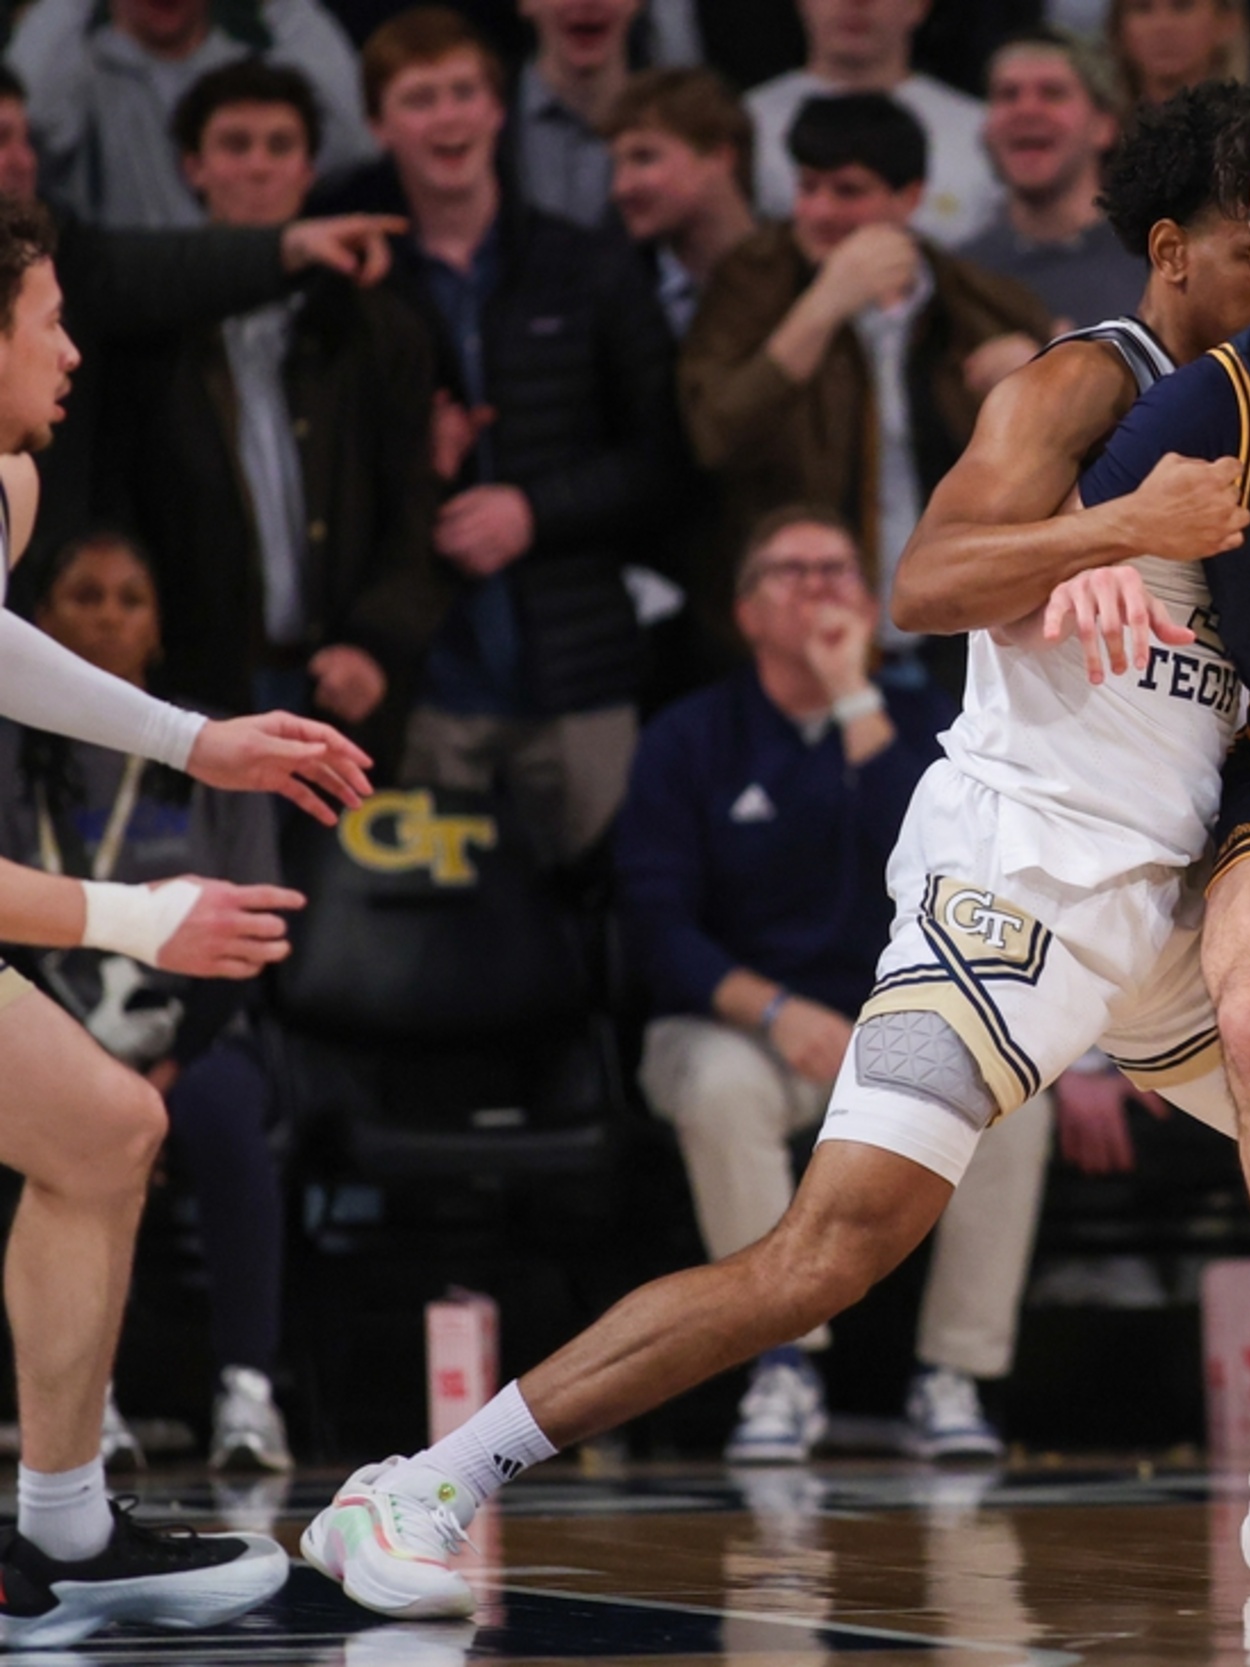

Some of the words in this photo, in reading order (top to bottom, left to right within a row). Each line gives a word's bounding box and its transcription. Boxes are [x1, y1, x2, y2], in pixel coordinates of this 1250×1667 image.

[1138, 645, 1237, 713] TECH
[337, 787, 498, 886] GT
[945, 888, 1023, 948] GT
